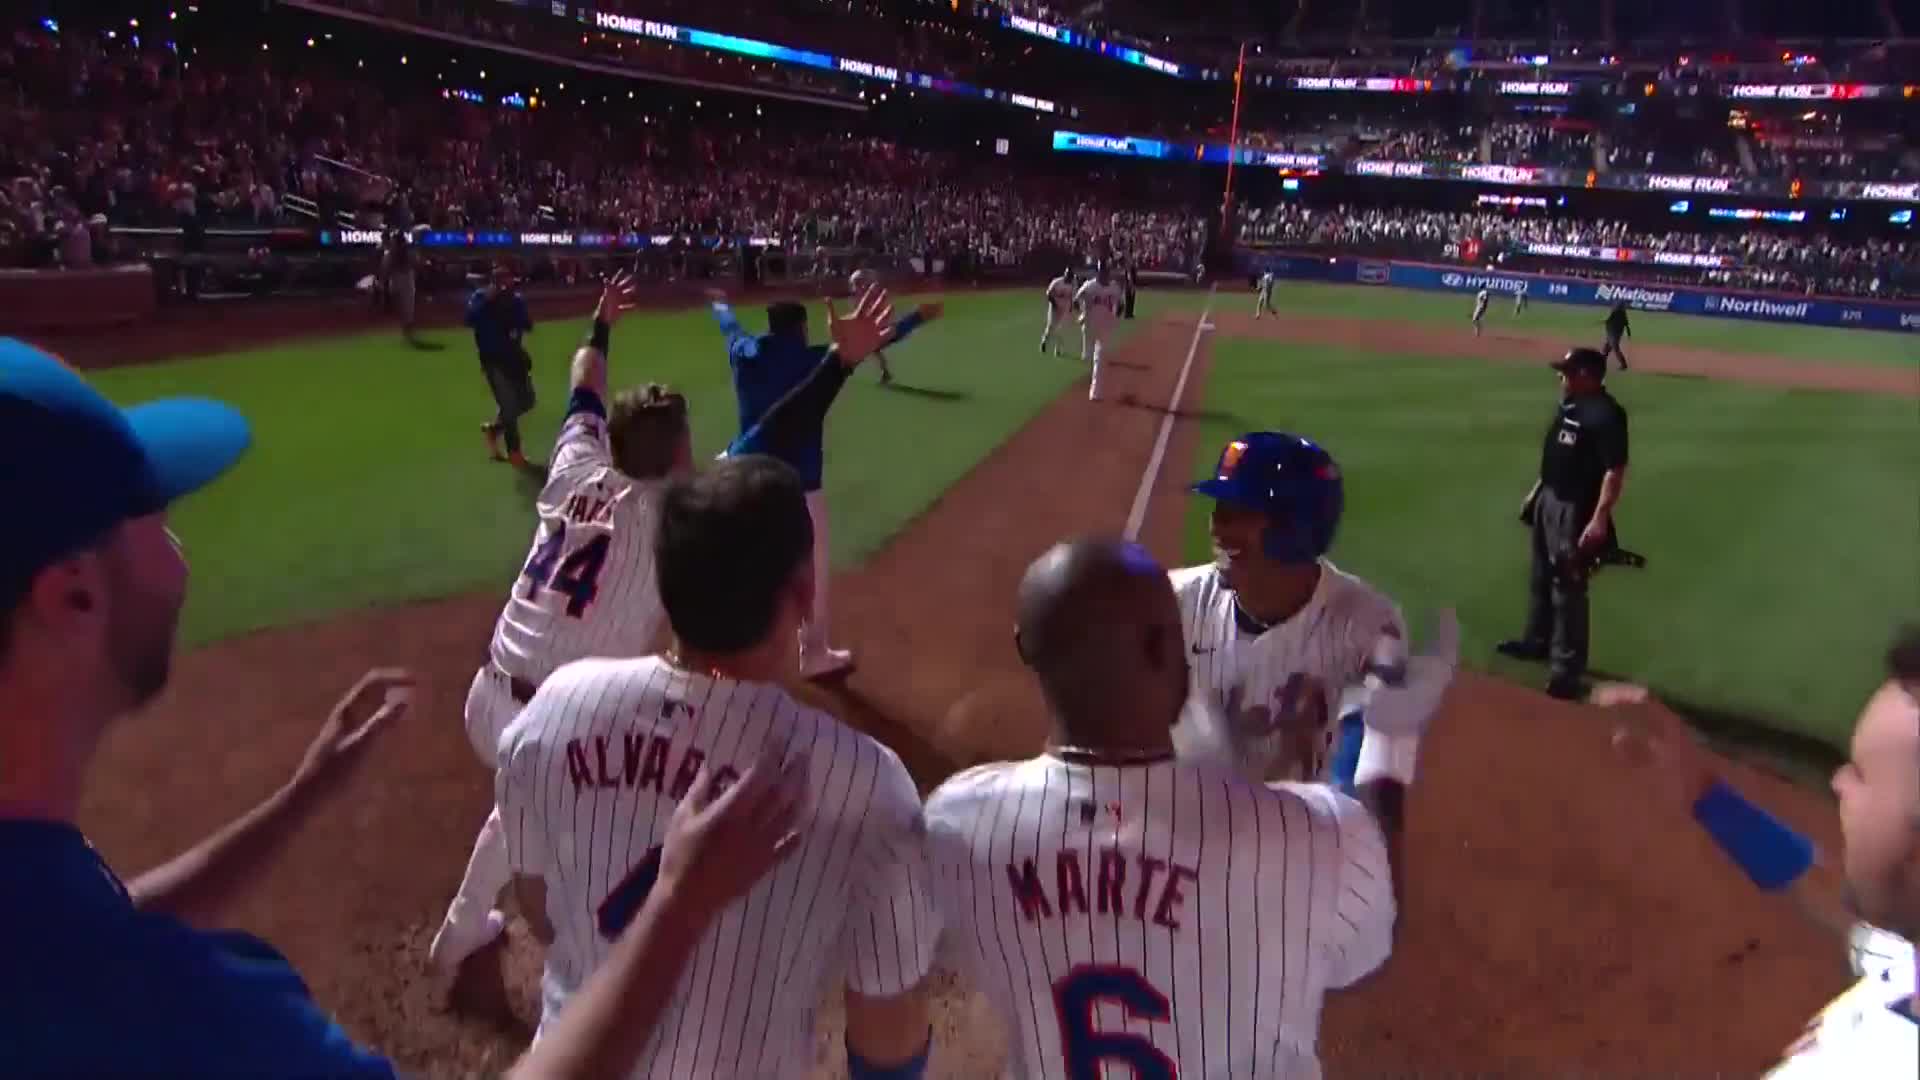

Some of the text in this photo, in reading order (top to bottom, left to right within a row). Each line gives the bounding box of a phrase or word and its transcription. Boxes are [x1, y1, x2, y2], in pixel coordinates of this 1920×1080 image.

[596, 12, 678, 39] HOME RUN
[840, 57, 897, 80] HOME RUN
[1299, 78, 1330, 88] HOME
[1331, 79, 1357, 89] RUN
[1501, 82, 1569, 94] HOME RUN
[1733, 85, 1811, 98] HOME RUN
[1357, 160, 1423, 176] HOME RUN
[1462, 166, 1533, 182] HOME RUN
[1650, 176, 1728, 192] HOME RUN
[1863, 182, 1915, 198] HOME
[520, 231, 550, 244] HOME
[1529, 242, 1590, 258] HOME RUN
[1655, 252, 1721, 268] HOME RUN
[1612, 286, 1674, 304] National
[1720, 298, 1808, 317] Northwell
[1006, 848, 1198, 932] MARTE
[1053, 963, 1178, 1080] 6
